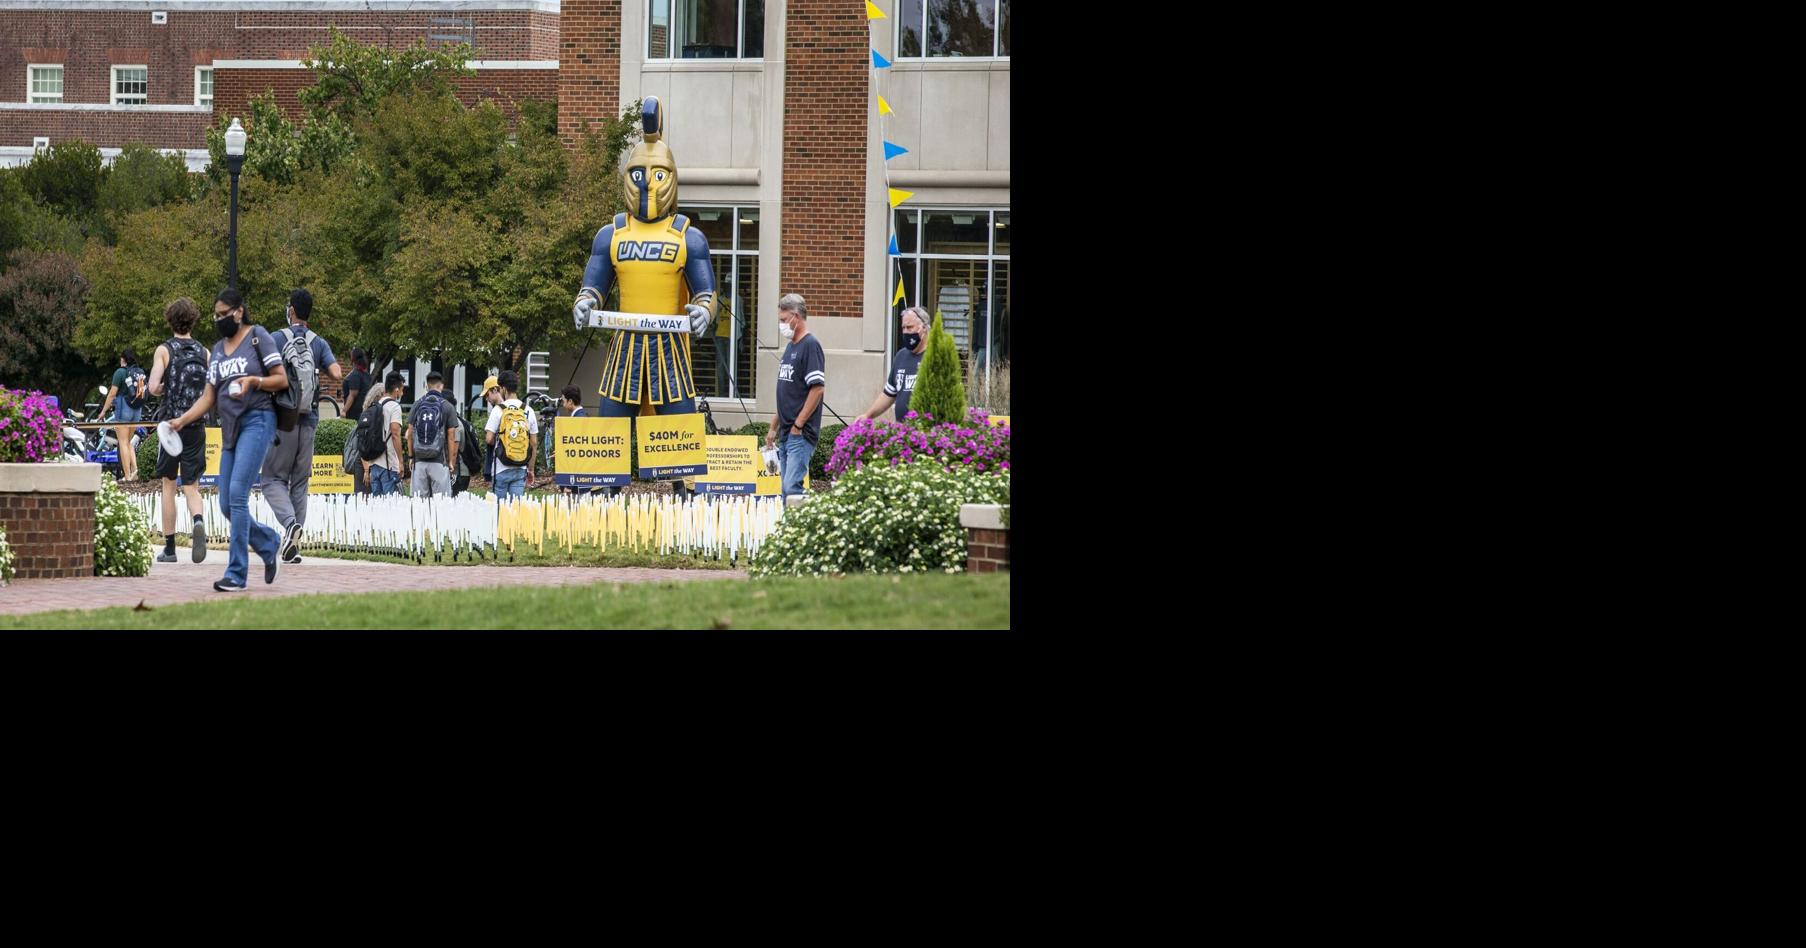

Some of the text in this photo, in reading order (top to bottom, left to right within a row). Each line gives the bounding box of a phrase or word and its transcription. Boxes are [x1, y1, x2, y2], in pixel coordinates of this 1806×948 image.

[617, 241, 680, 262] UNCG
[607, 316, 682, 329] LIGHT the WAY
[219, 361, 248, 378] WAY
[562, 436, 624, 445] EACH LIGHT:
[649, 430, 694, 442] $40M for
[565, 449, 621, 458] 10 DONORS
[644, 442, 701, 453] EXCELLENCE
